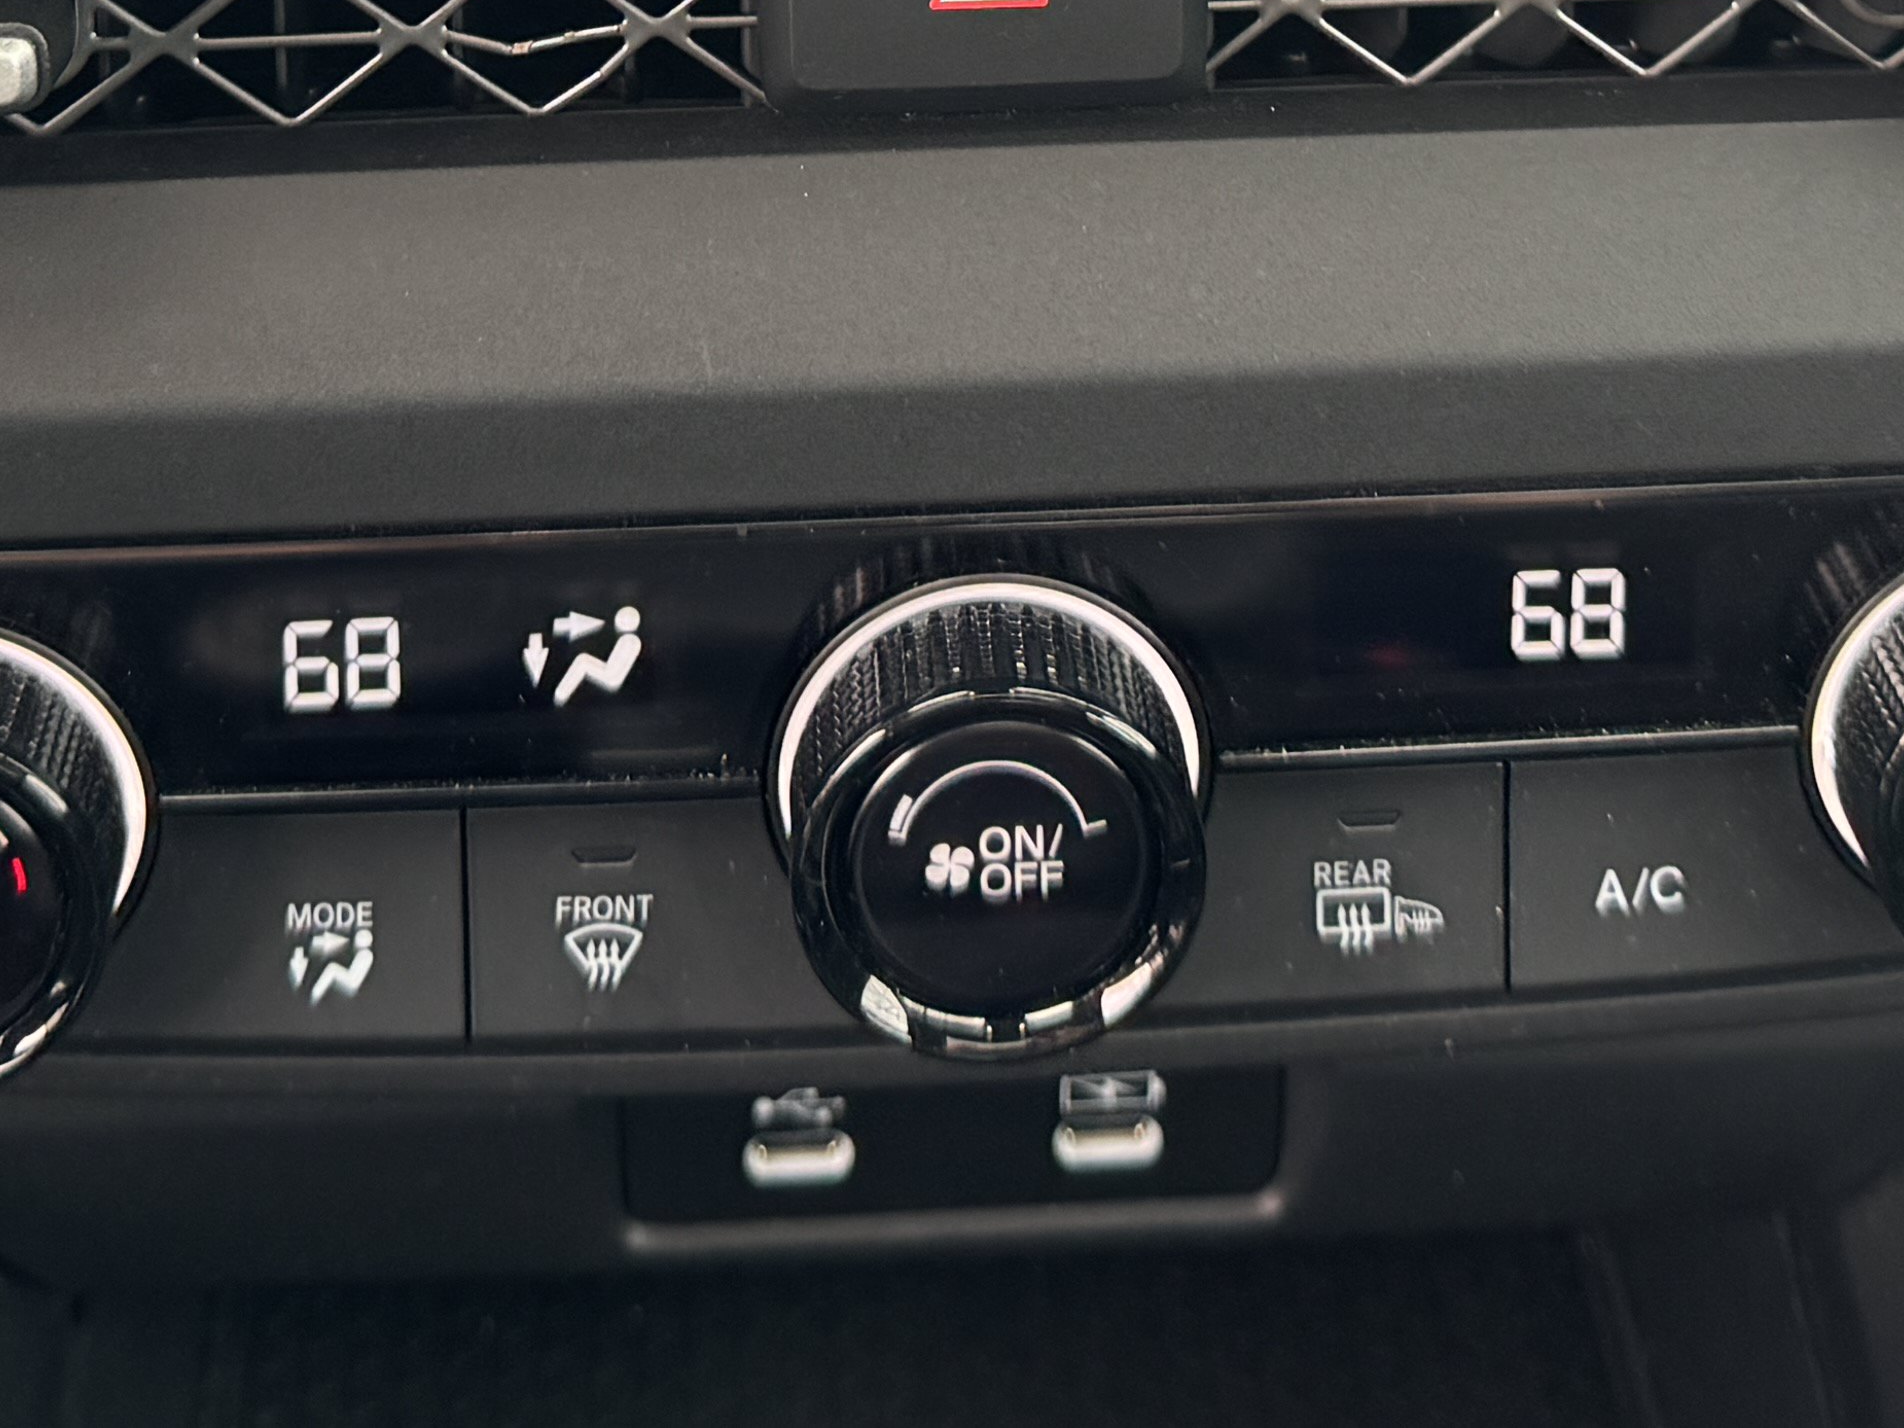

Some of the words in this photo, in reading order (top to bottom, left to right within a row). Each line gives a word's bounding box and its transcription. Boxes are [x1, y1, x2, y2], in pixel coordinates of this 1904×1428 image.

[1510, 567, 1626, 661] 68
[283, 616, 401, 713] 68
[979, 823, 1063, 860] ON/
[979, 860, 1064, 902] OFF
[1313, 858, 1391, 888] REAR
[1595, 865, 1688, 916] A/C
[286, 901, 374, 934] MODE
[554, 893, 654, 930] FRONT
